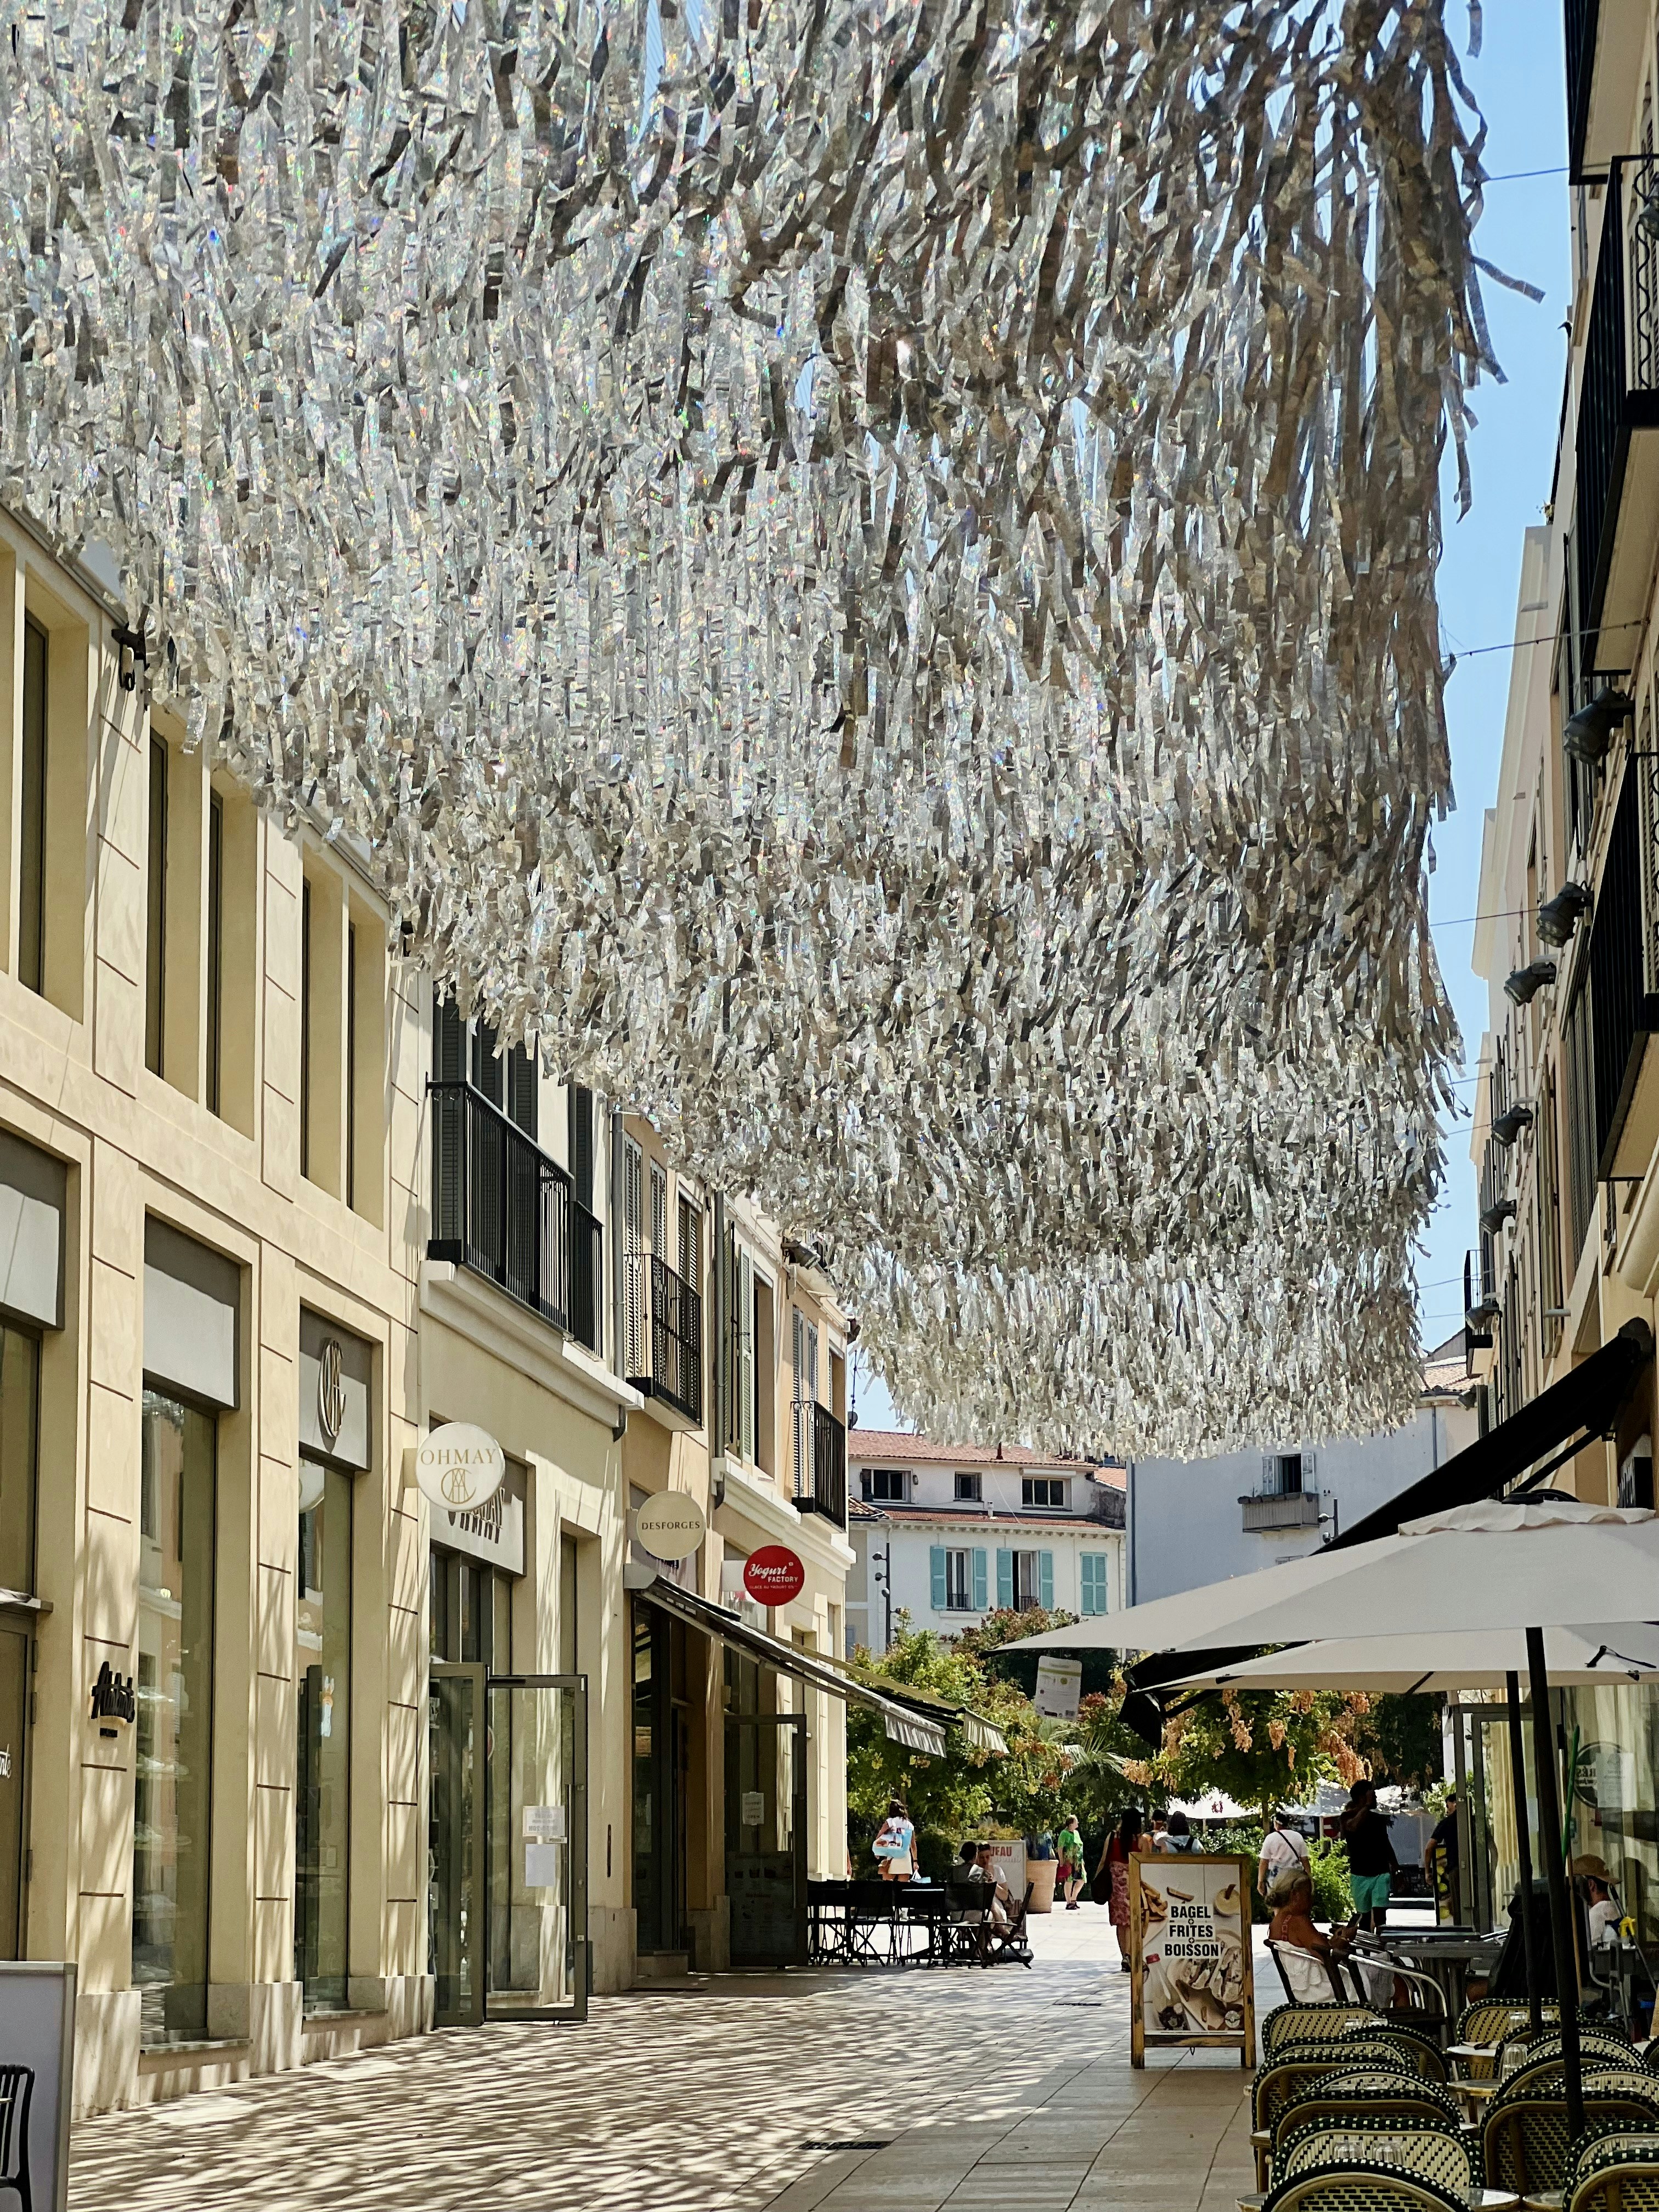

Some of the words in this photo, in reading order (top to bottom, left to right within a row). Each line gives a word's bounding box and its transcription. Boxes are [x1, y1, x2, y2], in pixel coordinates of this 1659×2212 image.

[421, 1448, 496, 1465] OHMAY
[641, 1521, 700, 1530] DESFORGES
[748, 1563, 787, 1579] Yogurt
[1171, 1906, 1211, 1918] BAGEL
[1169, 1925, 1213, 1937] FRITES
[1165, 1944, 1219, 1956] BOISSON
